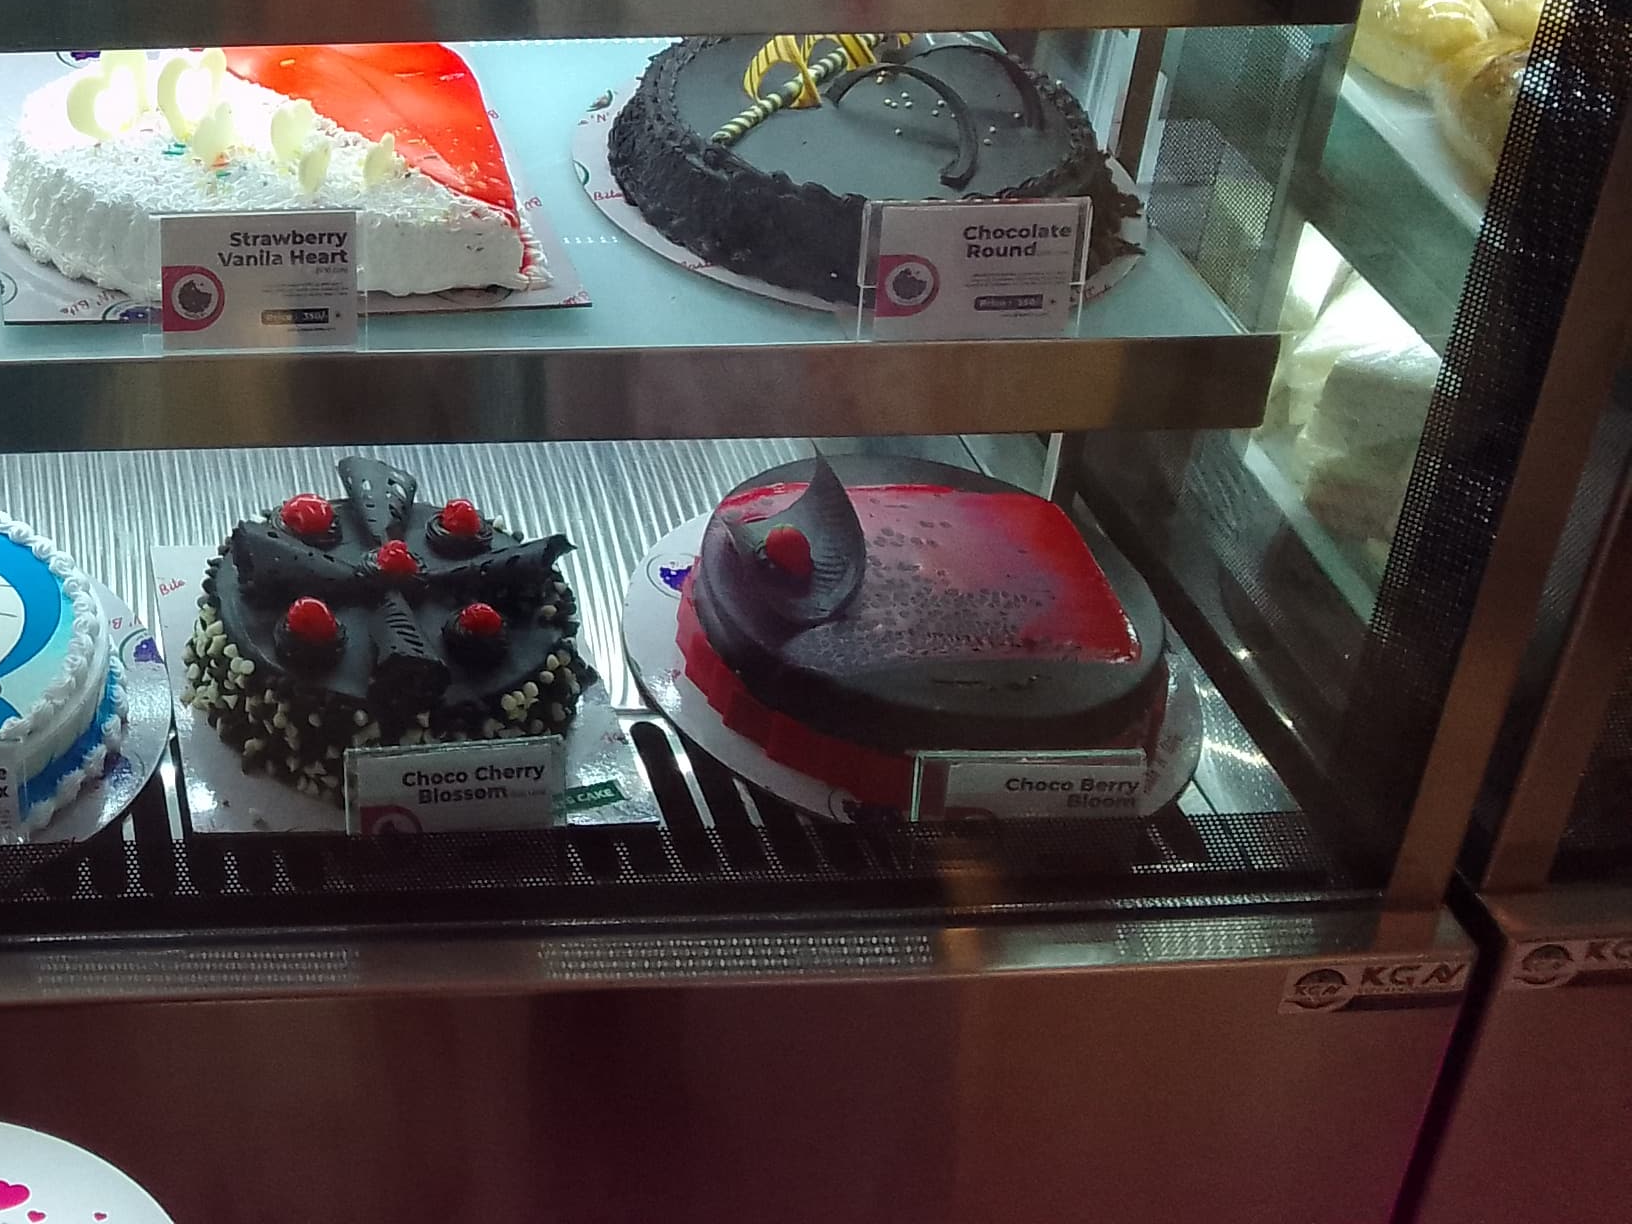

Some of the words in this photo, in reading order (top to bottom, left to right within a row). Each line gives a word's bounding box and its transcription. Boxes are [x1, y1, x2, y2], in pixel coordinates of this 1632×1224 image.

[230, 230, 348, 248] Strawberry
[963, 224, 1072, 240] Chocolate
[218, 250, 284, 267] Vanila
[290, 248, 348, 265] Heart
[967, 242, 1038, 258] Round
[402, 770, 468, 788] Choco
[475, 764, 545, 782] Cherry
[1005, 777, 1074, 793] Choco
[1080, 778, 1140, 794] Berry
[419, 785, 508, 804] Blossom
[577, 788, 615, 802] CAKE
[1068, 794, 1137, 809] Bloom
